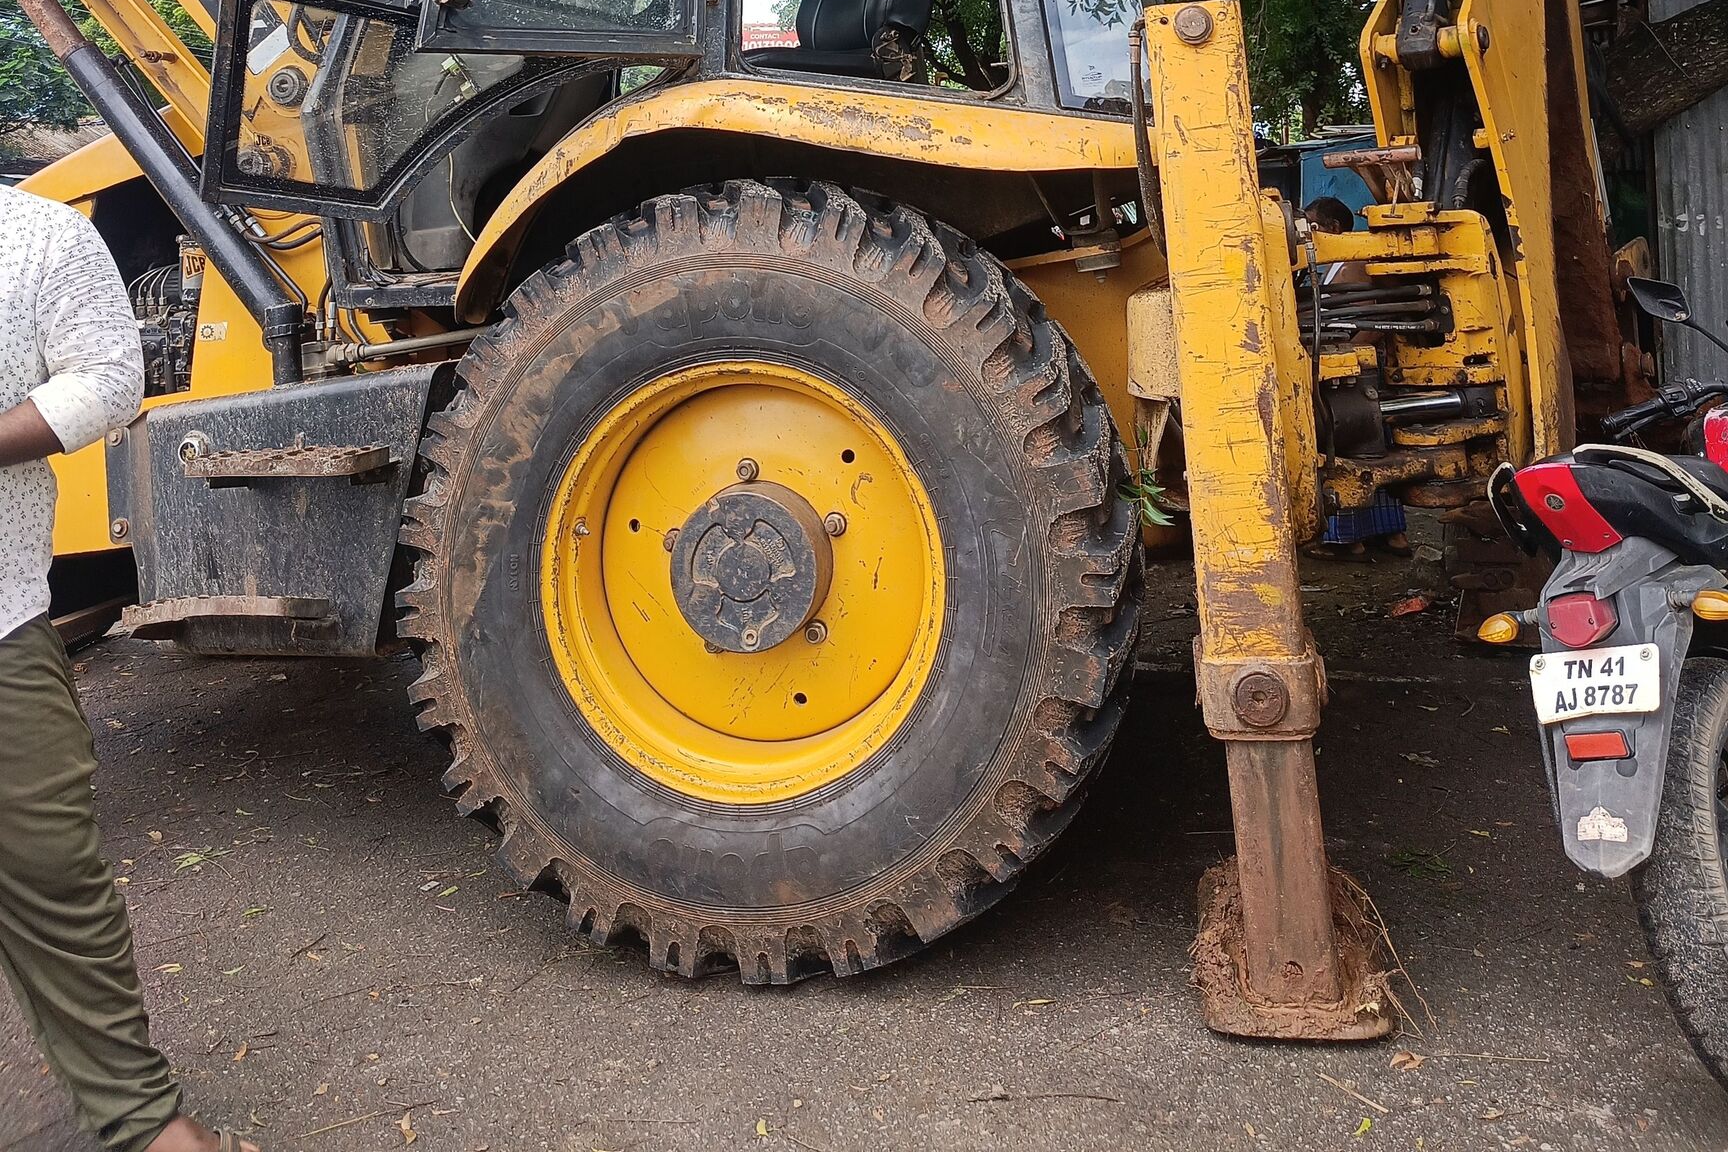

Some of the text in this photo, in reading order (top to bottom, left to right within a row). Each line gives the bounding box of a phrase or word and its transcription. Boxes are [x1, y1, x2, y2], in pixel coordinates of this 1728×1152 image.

[255, 134, 271, 146] JCB
[185, 254, 205, 276] JCB
[1564, 656, 1625, 679] TN 41
[1555, 683, 1638, 714] AJ 8787
